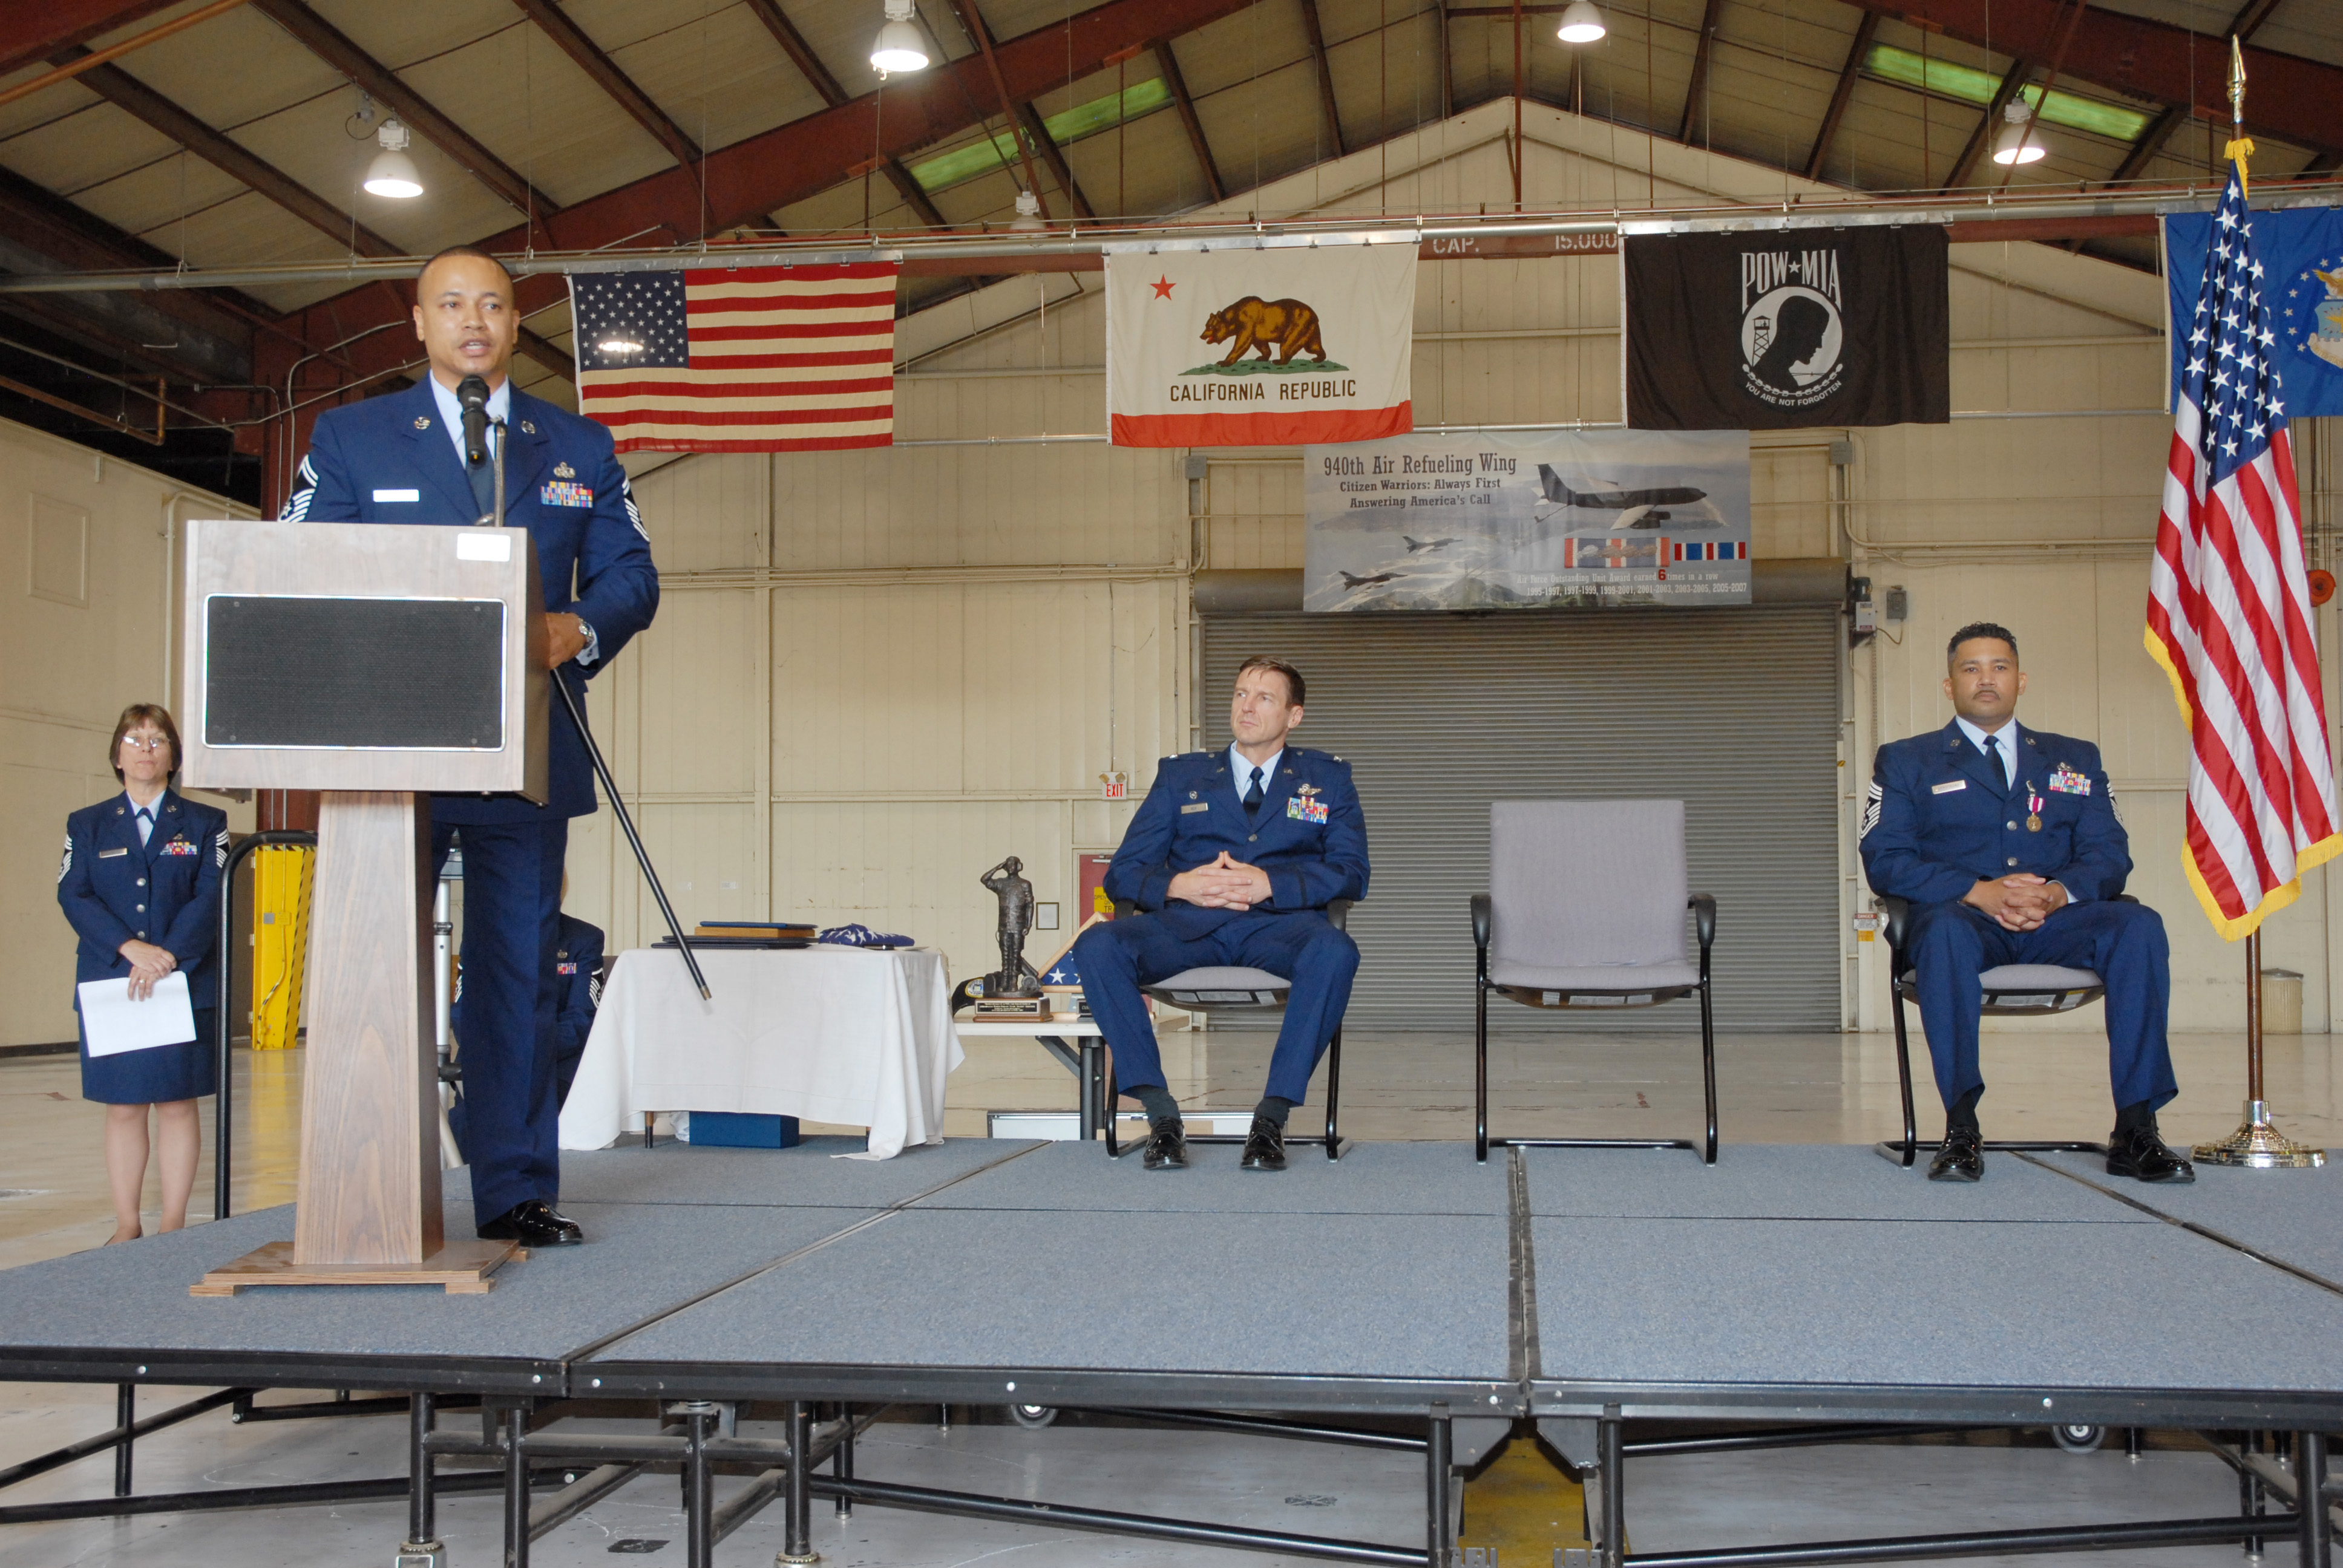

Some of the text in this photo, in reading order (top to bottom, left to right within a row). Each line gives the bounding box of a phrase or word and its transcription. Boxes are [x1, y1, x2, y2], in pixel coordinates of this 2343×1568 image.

[1433, 237, 1480, 253] CAP.
[1741, 249, 1842, 315] POW MIA
[1170, 380, 1356, 402] CALIFORNIA REPUBLIC
[1745, 381, 1760, 396] YOU
[1760, 393, 1776, 403] ARE
[1798, 380, 1842, 406] FORGOTTEN
[1324, 452, 1517, 475] 940th Air Refueling Wing
[1340, 477, 1501, 492] Citizen Warriors: Always First
[1349, 494, 1491, 509] Answering America's Call
[1517, 575, 1527, 584] Air
[1530, 575, 1548, 583] Force
[1550, 573, 1589, 583] Outstanding
[1592, 573, 1606, 582] Unit
[1609, 573, 1631, 582] Award
[1634, 572, 1657, 581] earned
[1658, 569, 1666, 581] 6
[1667, 572, 1685, 581] times
[1688, 572, 1694, 580] in
[1527, 583, 1747, 596] 1995-1997, 1997-1999, 1999-2001, 2001-2003, 2003-2005, 2005-2007
[1106, 783, 1124, 797] EXIT
